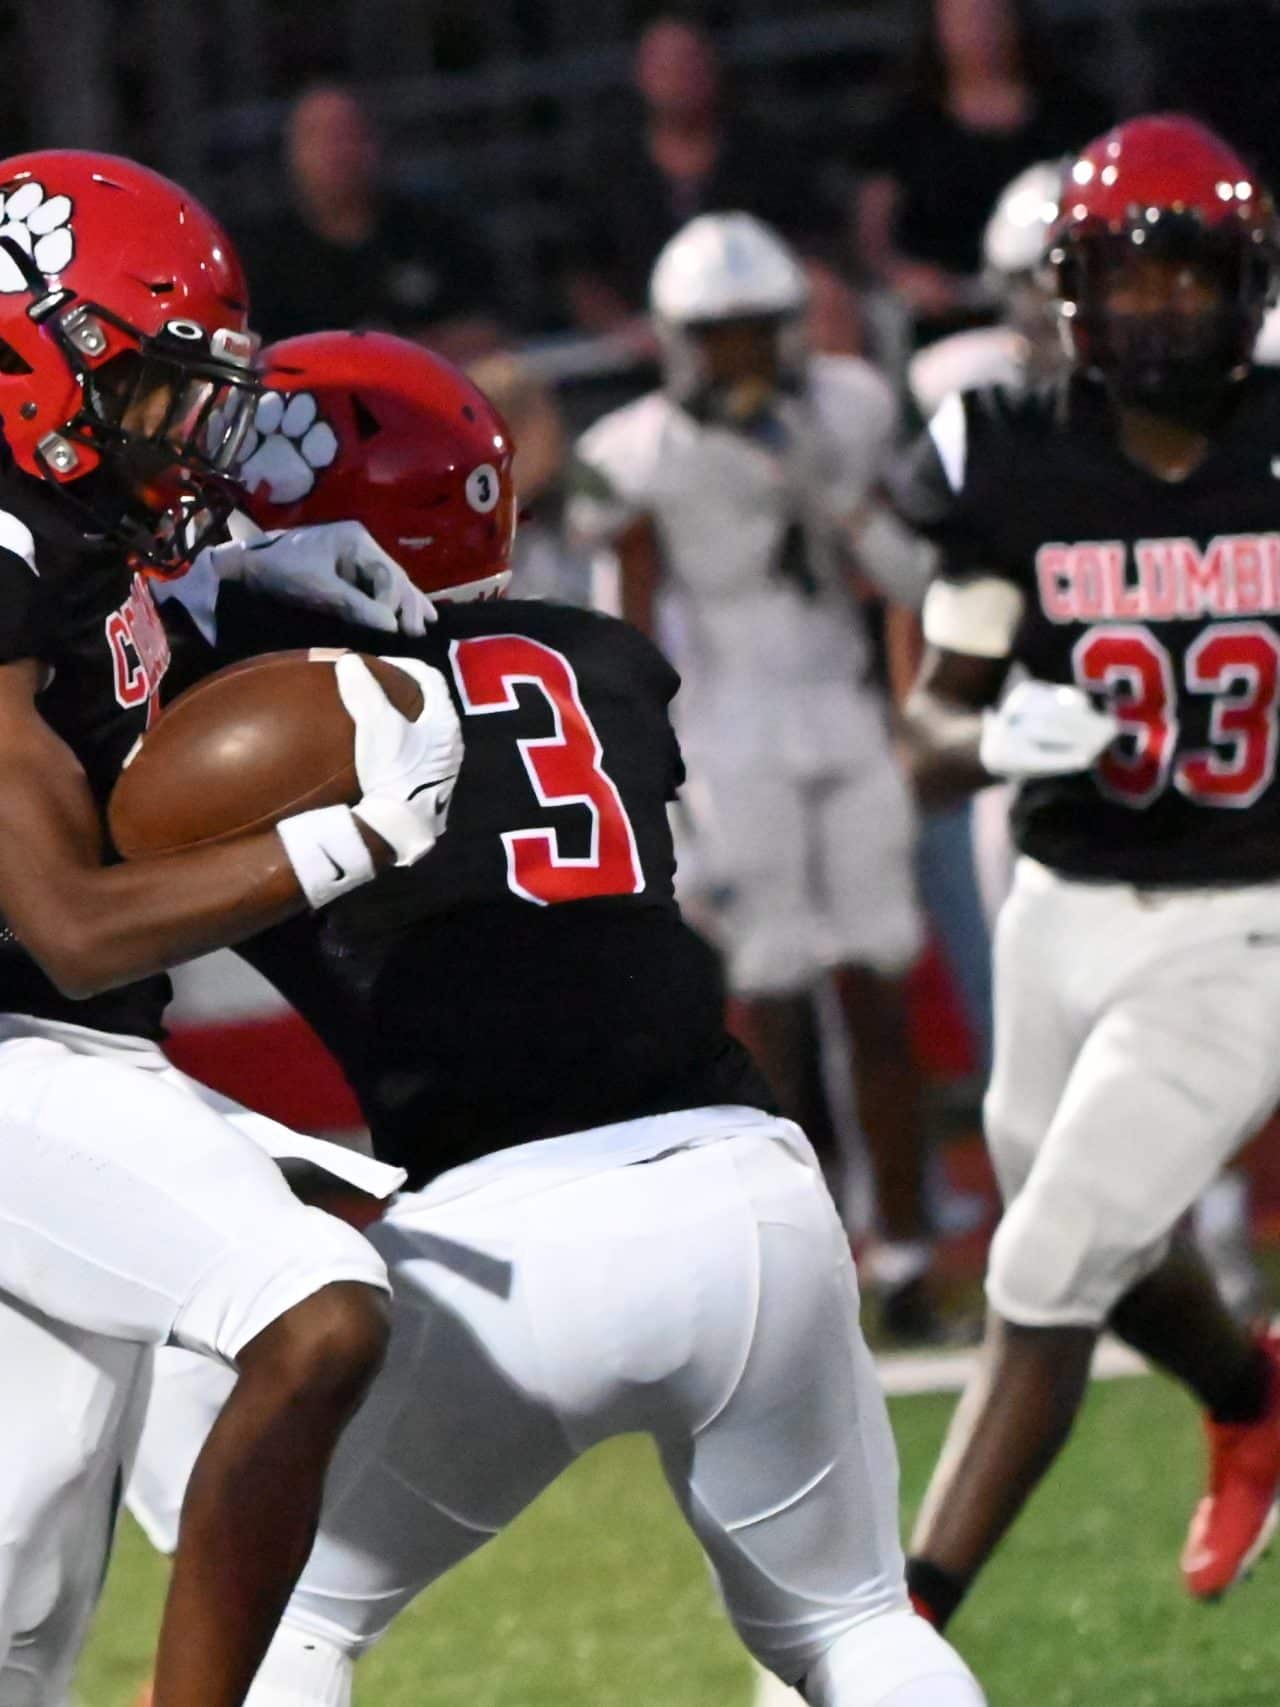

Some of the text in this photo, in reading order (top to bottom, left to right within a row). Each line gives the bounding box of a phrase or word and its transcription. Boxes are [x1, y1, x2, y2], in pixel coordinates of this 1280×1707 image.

[477, 475, 491, 503] 3
[448, 633, 646, 907] 3
[1071, 620, 1280, 810] 33
